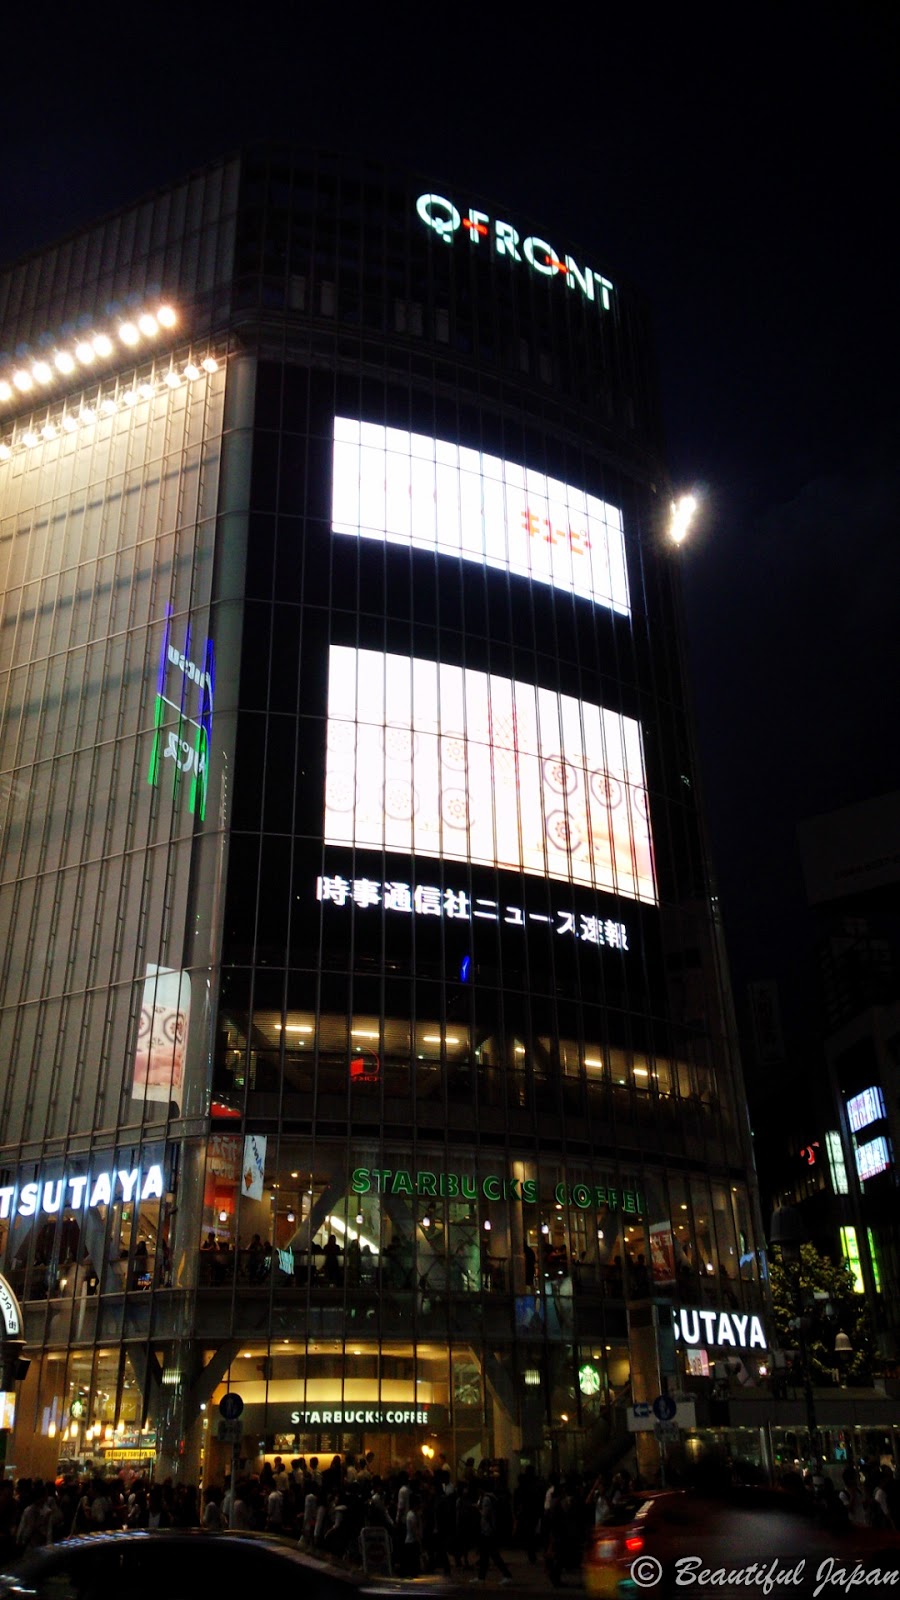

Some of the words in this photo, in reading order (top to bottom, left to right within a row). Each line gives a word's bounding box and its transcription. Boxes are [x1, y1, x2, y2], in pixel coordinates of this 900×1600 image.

[316, 875, 630, 951] 時事通信社ニュース速報
[0, 1164, 164, 1219] TSUTAYA
[352, 1167, 538, 1205] STARBUCKS
[291, 1410, 383, 1424] STARBUCKS
[386, 1410, 428, 1424] COFFEE
